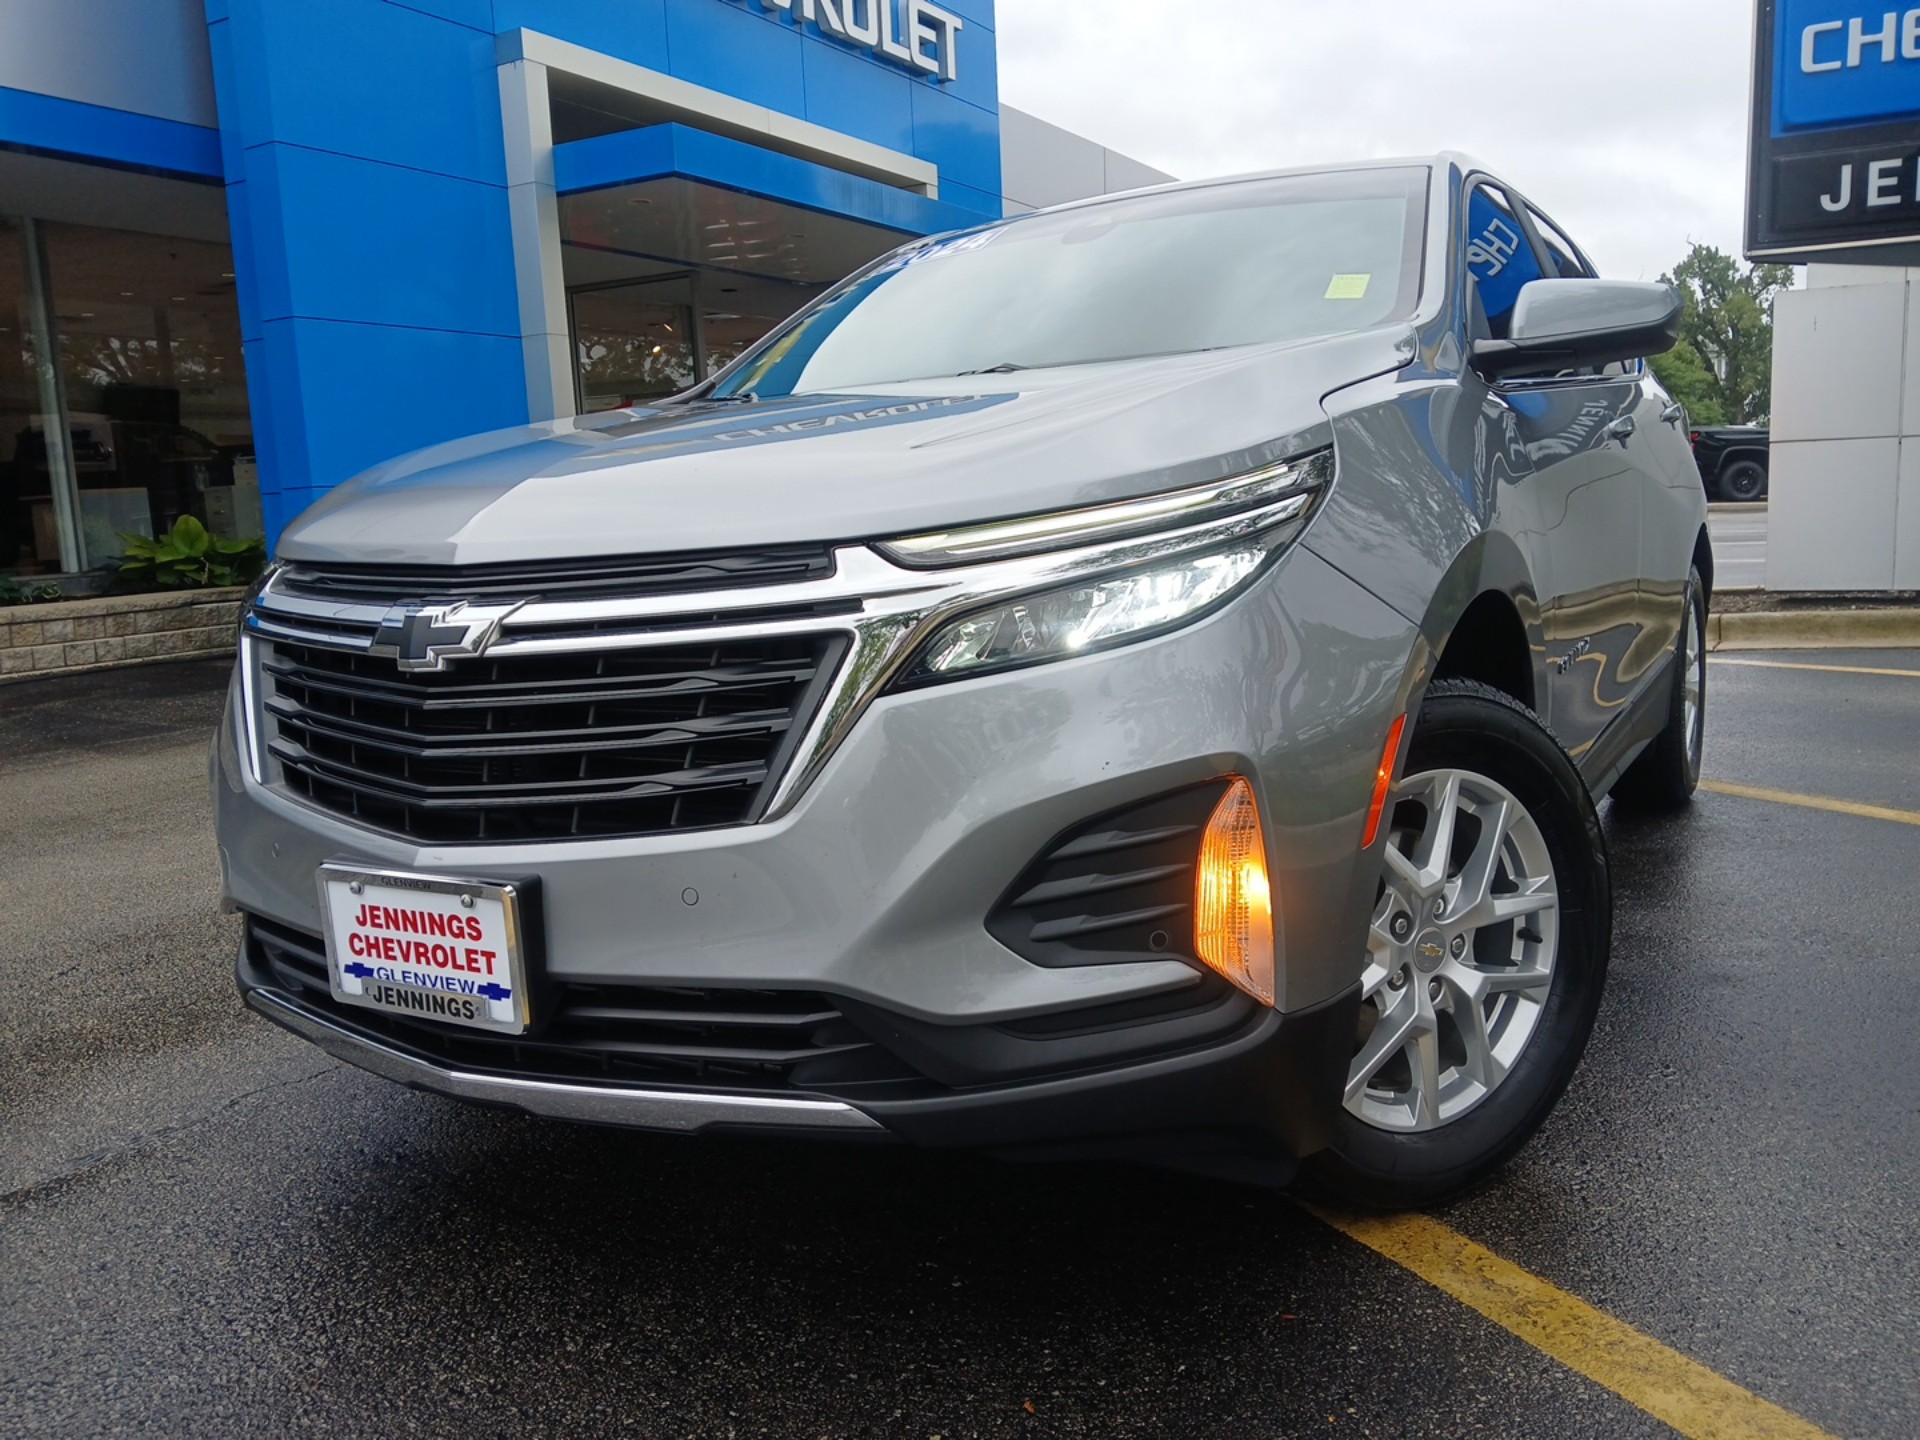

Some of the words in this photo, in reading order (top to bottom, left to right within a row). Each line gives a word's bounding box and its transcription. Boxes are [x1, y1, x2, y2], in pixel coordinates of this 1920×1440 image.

[1820, 157, 1920, 212] JE
[381, 877, 432, 890] GLENVIEW
[355, 904, 482, 941] JENNINGS
[348, 933, 496, 975] CHEVROLET
[376, 967, 475, 994] GLENVIEW
[373, 985, 475, 1020] JENNINGS
